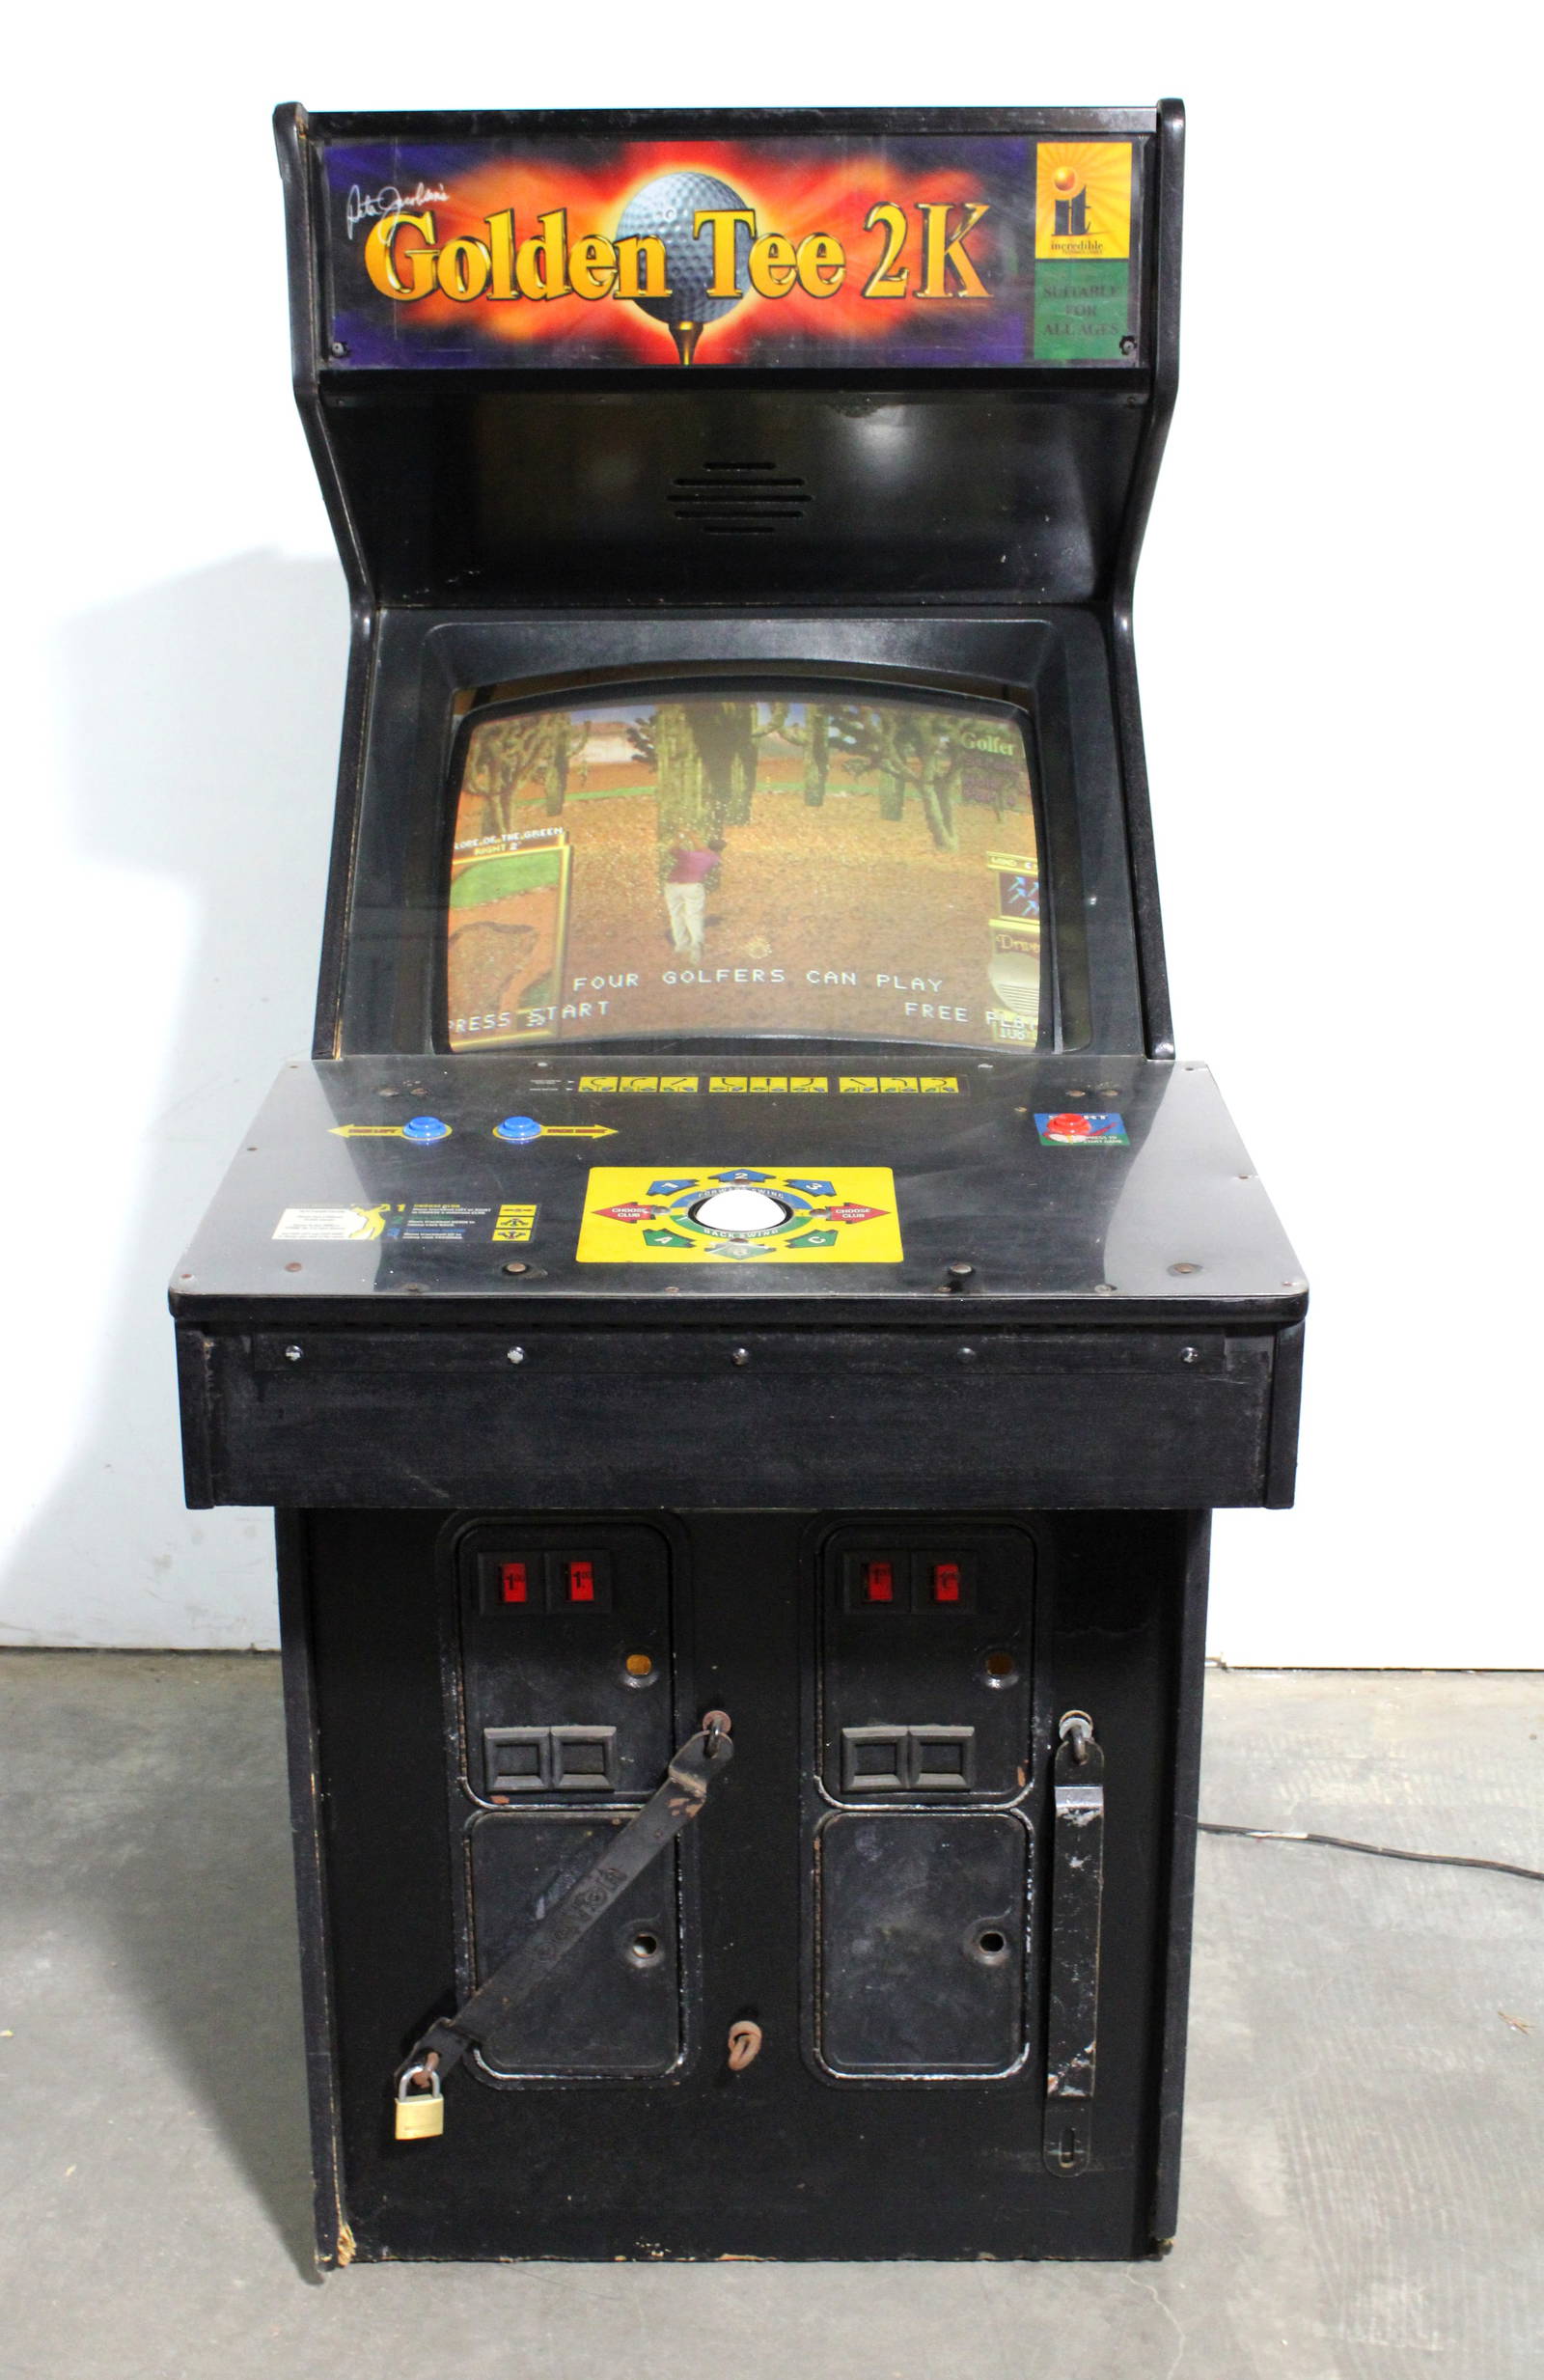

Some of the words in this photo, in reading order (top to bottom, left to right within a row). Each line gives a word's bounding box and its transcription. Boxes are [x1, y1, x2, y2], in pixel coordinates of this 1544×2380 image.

[364, 208, 673, 302] Golden
[693, 208, 847, 299] Tee
[862, 202, 994, 299] 2K
[1050, 239, 1103, 251] incredible
[1065, 303, 1097, 317] FOR
[1044, 322, 1077, 336] ALL
[961, 732, 1015, 757] Golfer
[572, 972, 640, 992] FOUR
[661, 968, 786, 985] GOLFERS
[806, 969, 857, 986] CAN
[876, 973, 943, 993] PLAY
[530, 1000, 610, 1024] START
[904, 1002, 970, 1022] FREE
[653, 1235, 674, 1245] A
[703, 1229, 734, 1238] BACK
[807, 1235, 827, 1244] C
